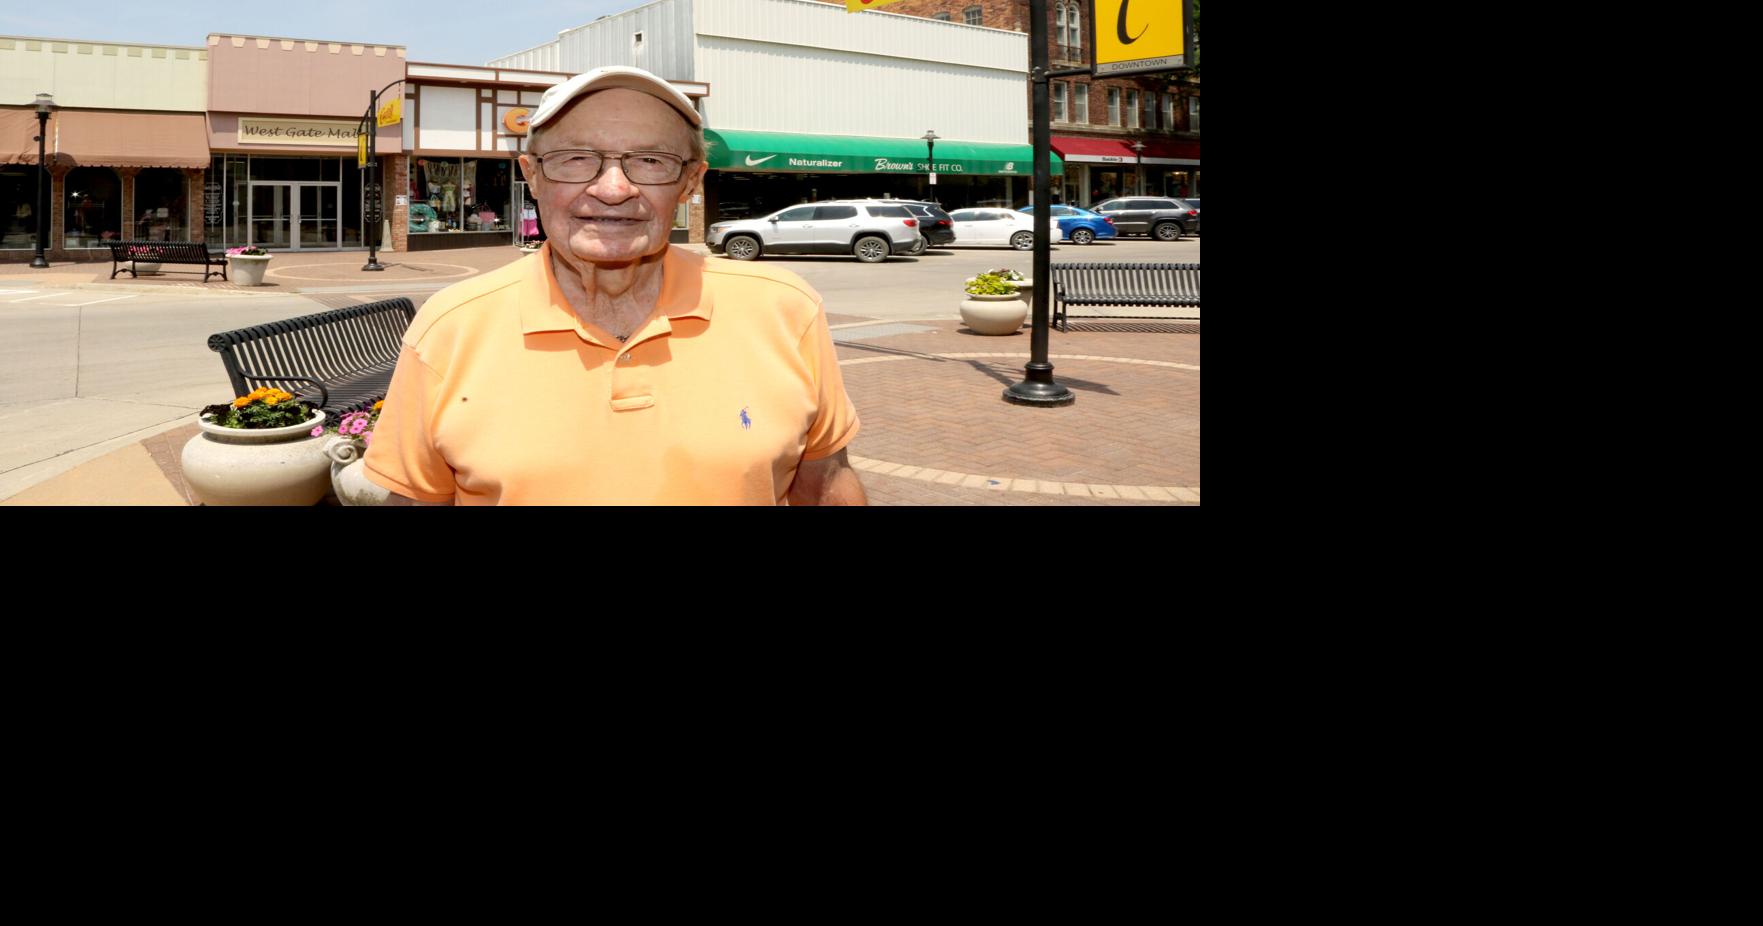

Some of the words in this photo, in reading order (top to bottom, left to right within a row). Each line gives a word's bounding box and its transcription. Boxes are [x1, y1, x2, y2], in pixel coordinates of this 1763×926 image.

[1111, 58, 1167, 71] DOWNTOWN
[244, 125, 282, 138] West
[285, 127, 326, 139] Gate
[327, 127, 361, 139] Mal
[788, 158, 843, 168] Naturalizer
[874, 158, 914, 171] Brown's
[938, 163, 950, 171] FIT
